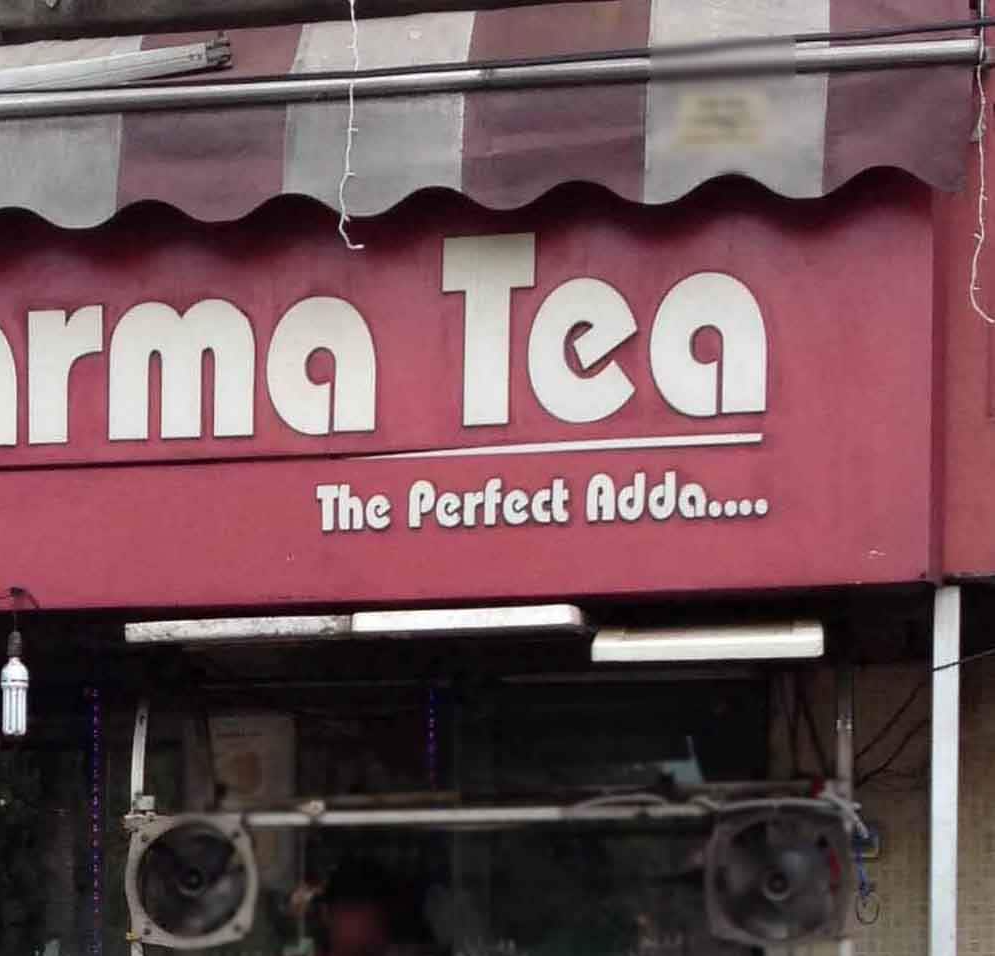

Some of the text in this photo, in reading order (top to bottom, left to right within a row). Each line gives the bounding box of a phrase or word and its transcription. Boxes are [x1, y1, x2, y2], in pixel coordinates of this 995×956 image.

[442, 232, 768, 426] Tea
[316, 484, 391, 531] The
[408, 478, 569, 529] Perfect
